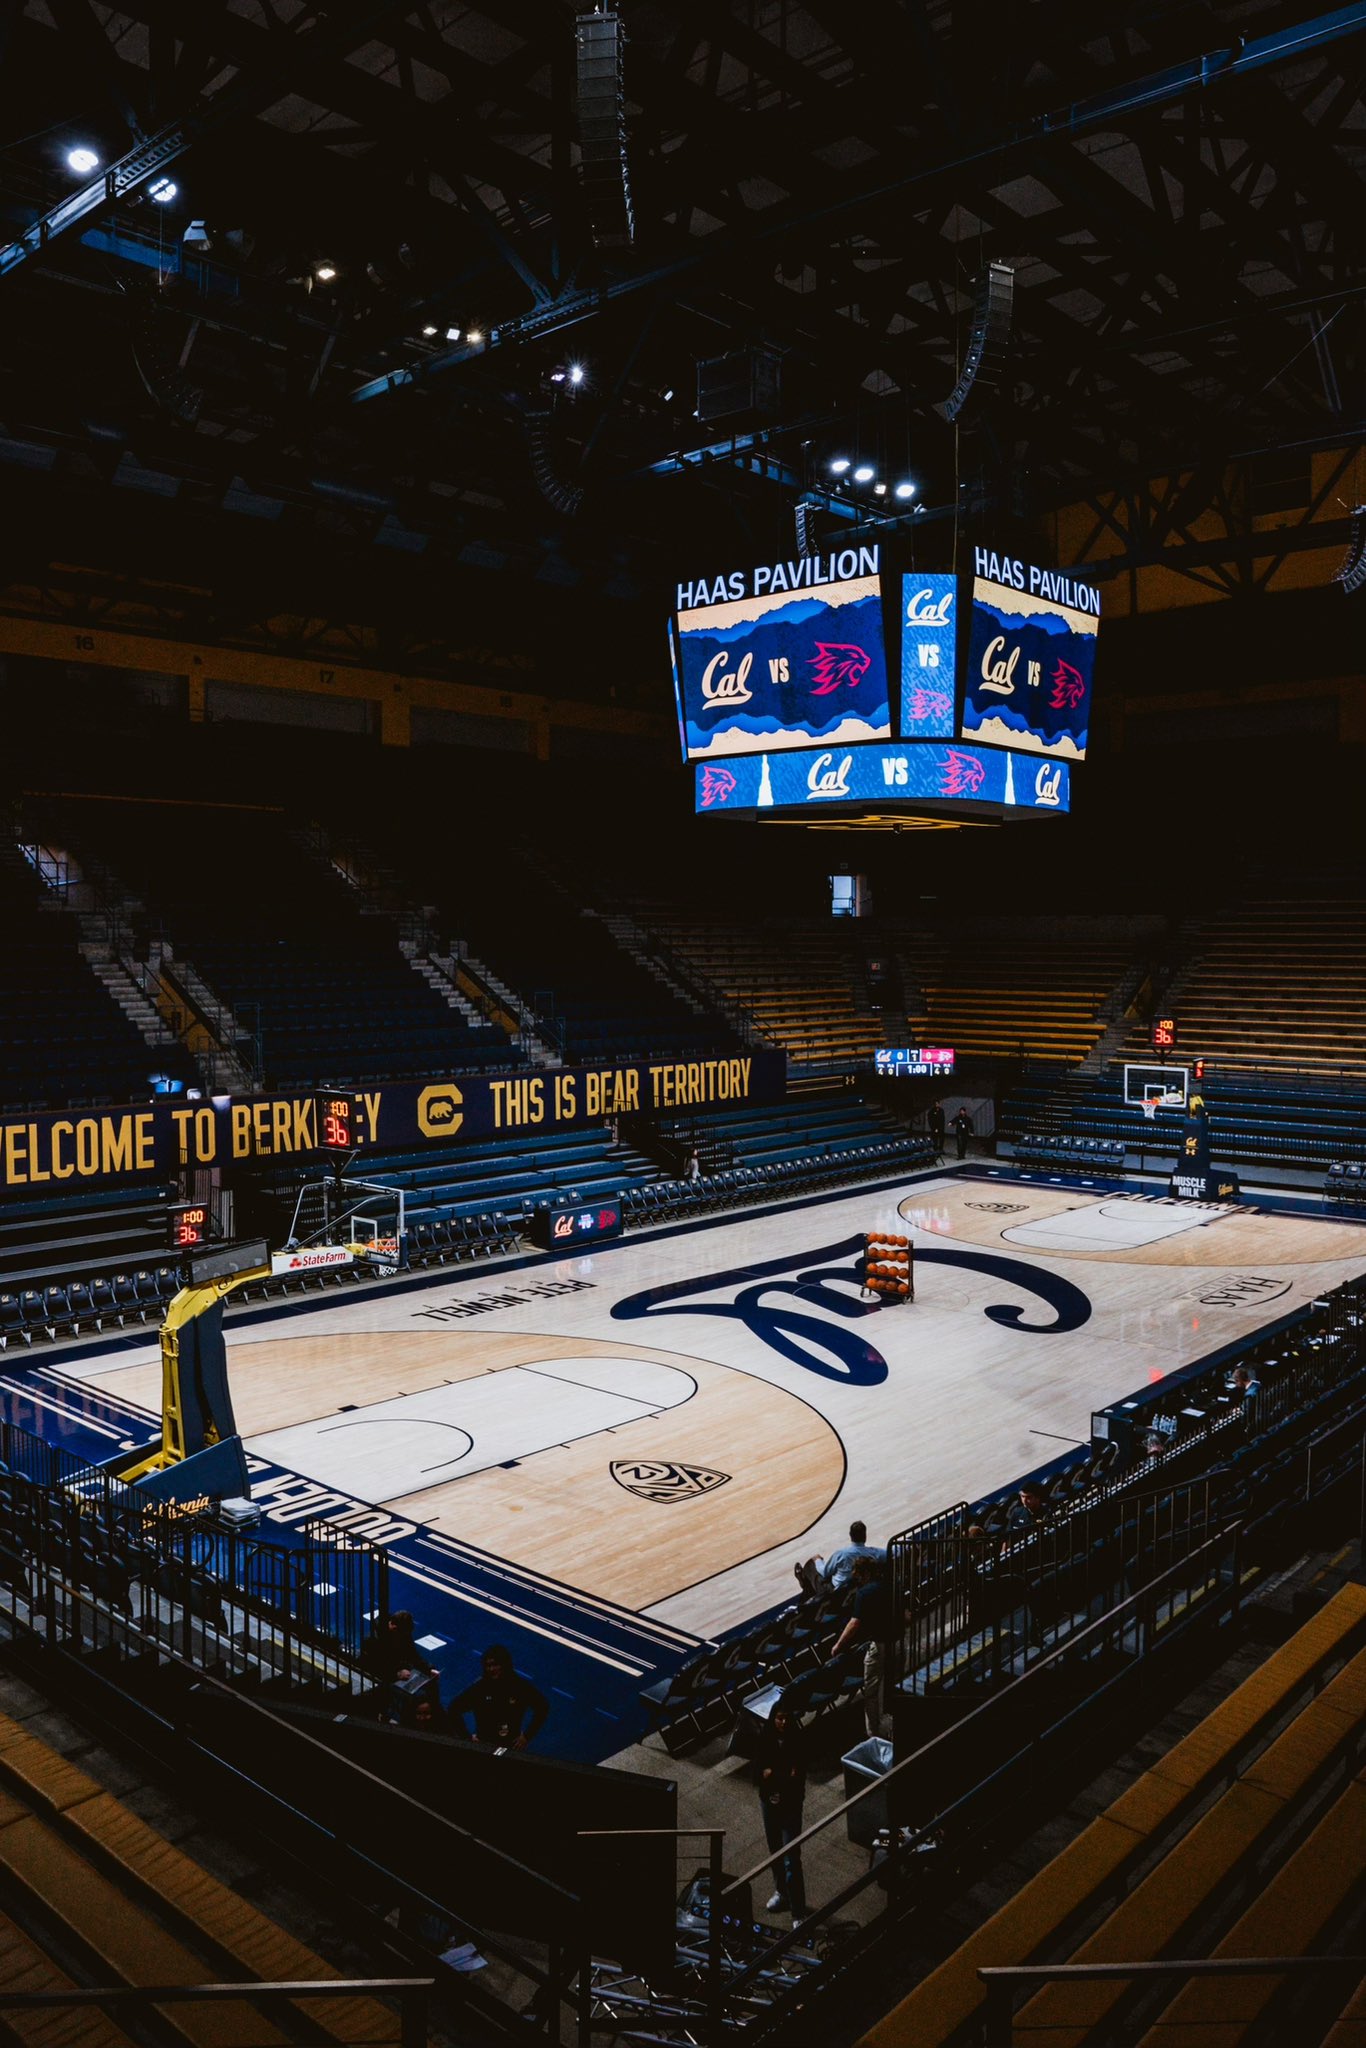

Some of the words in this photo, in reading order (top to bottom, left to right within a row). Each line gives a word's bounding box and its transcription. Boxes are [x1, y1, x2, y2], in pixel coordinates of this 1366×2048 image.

[677, 571, 745, 610] HAAS
[753, 544, 880, 593] PAVILION
[974, 546, 1025, 586] HAAS
[1029, 568, 1101, 616] PAVILION
[906, 589, 953, 628] Cal
[918, 644, 940, 669] VS
[978, 636, 1021, 696] Cal
[1027, 660, 1041, 688] VS
[701, 651, 754, 711] Cal
[768, 657, 790, 685] VS
[806, 753, 854, 801] Cal
[882, 757, 909, 786] VS
[1034, 763, 1062, 807] Cal
[907, 1064, 928, 1074] 1:00
[488, 1077, 545, 1129] THIS
[554, 1074, 577, 1121] IS
[586, 1068, 640, 1117] BEAR
[649, 1057, 753, 1109] TERRITORY
[0, 1113, 155, 1185] ELCOME
[171, 1108, 217, 1165] TO
[231, 1092, 382, 1159] BERKY
[326, 1116, 348, 1145] 36
[1172, 1175, 1207, 1190] MUSCLE
[1178, 1186, 1200, 1199] MILK
[183, 1210, 204, 1224] 1:00
[553, 1215, 575, 1239] Cal
[179, 1225, 198, 1243] 36
[518, 1279, 599, 1299] PETE
[1199, 1276, 1285, 1308] HAAS
[410, 1294, 533, 1322] NEWELL
